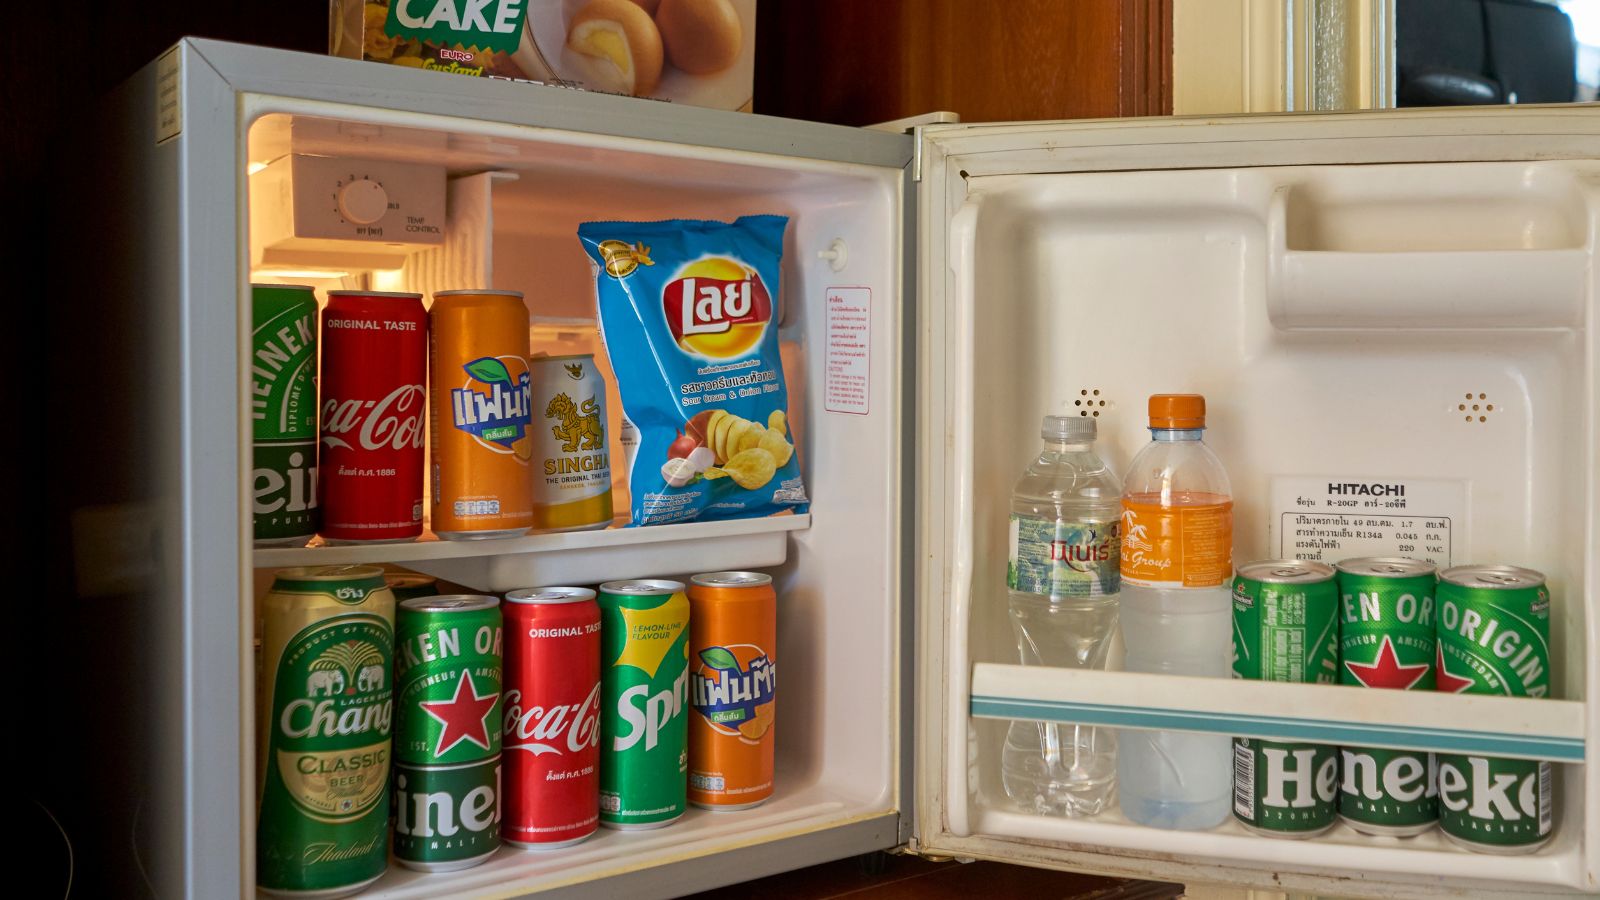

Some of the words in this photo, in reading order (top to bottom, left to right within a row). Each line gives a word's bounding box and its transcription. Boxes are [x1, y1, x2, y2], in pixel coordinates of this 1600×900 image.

[396, 0, 521, 34] CAKE
[440, 49, 474, 62] EURO
[407, 216, 425, 224] TEMP
[406, 226, 440, 234] CONTROL
[327, 319, 380, 330] ORIGINAL
[383, 320, 417, 331] TASTE
[453, 375, 531, 426] แฟนต้
[682, 397, 701, 407] Sour
[729, 390, 737, 400] &
[739, 386, 762, 397] Onion
[322, 384, 425, 451] ca-Col
[544, 453, 609, 476] SINGHA
[561, 474, 590, 484] ORIGINAL
[1328, 483, 1405, 497] HITACHI
[1327, 499, 1359, 507] R-20GP
[1353, 519, 1364, 527] 49
[1356, 531, 1383, 539] R134a
[1395, 532, 1418, 540] 0.045
[1399, 544, 1415, 552] 220
[1132, 551, 1171, 571] Group
[528, 625, 583, 639] ORIGINAL
[633, 622, 681, 633] LEMON-LIME
[632, 631, 671, 641] FLAVOUR
[288, 629, 337, 666] PRODUCT
[343, 626, 357, 634] OF
[341, 694, 377, 706] LAGER
[280, 697, 393, 739] Chang
[297, 749, 386, 775] CLASSIC
[330, 775, 365, 788] BEER
[1357, 801, 1401, 815] MALT
[431, 837, 475, 850] MALT
